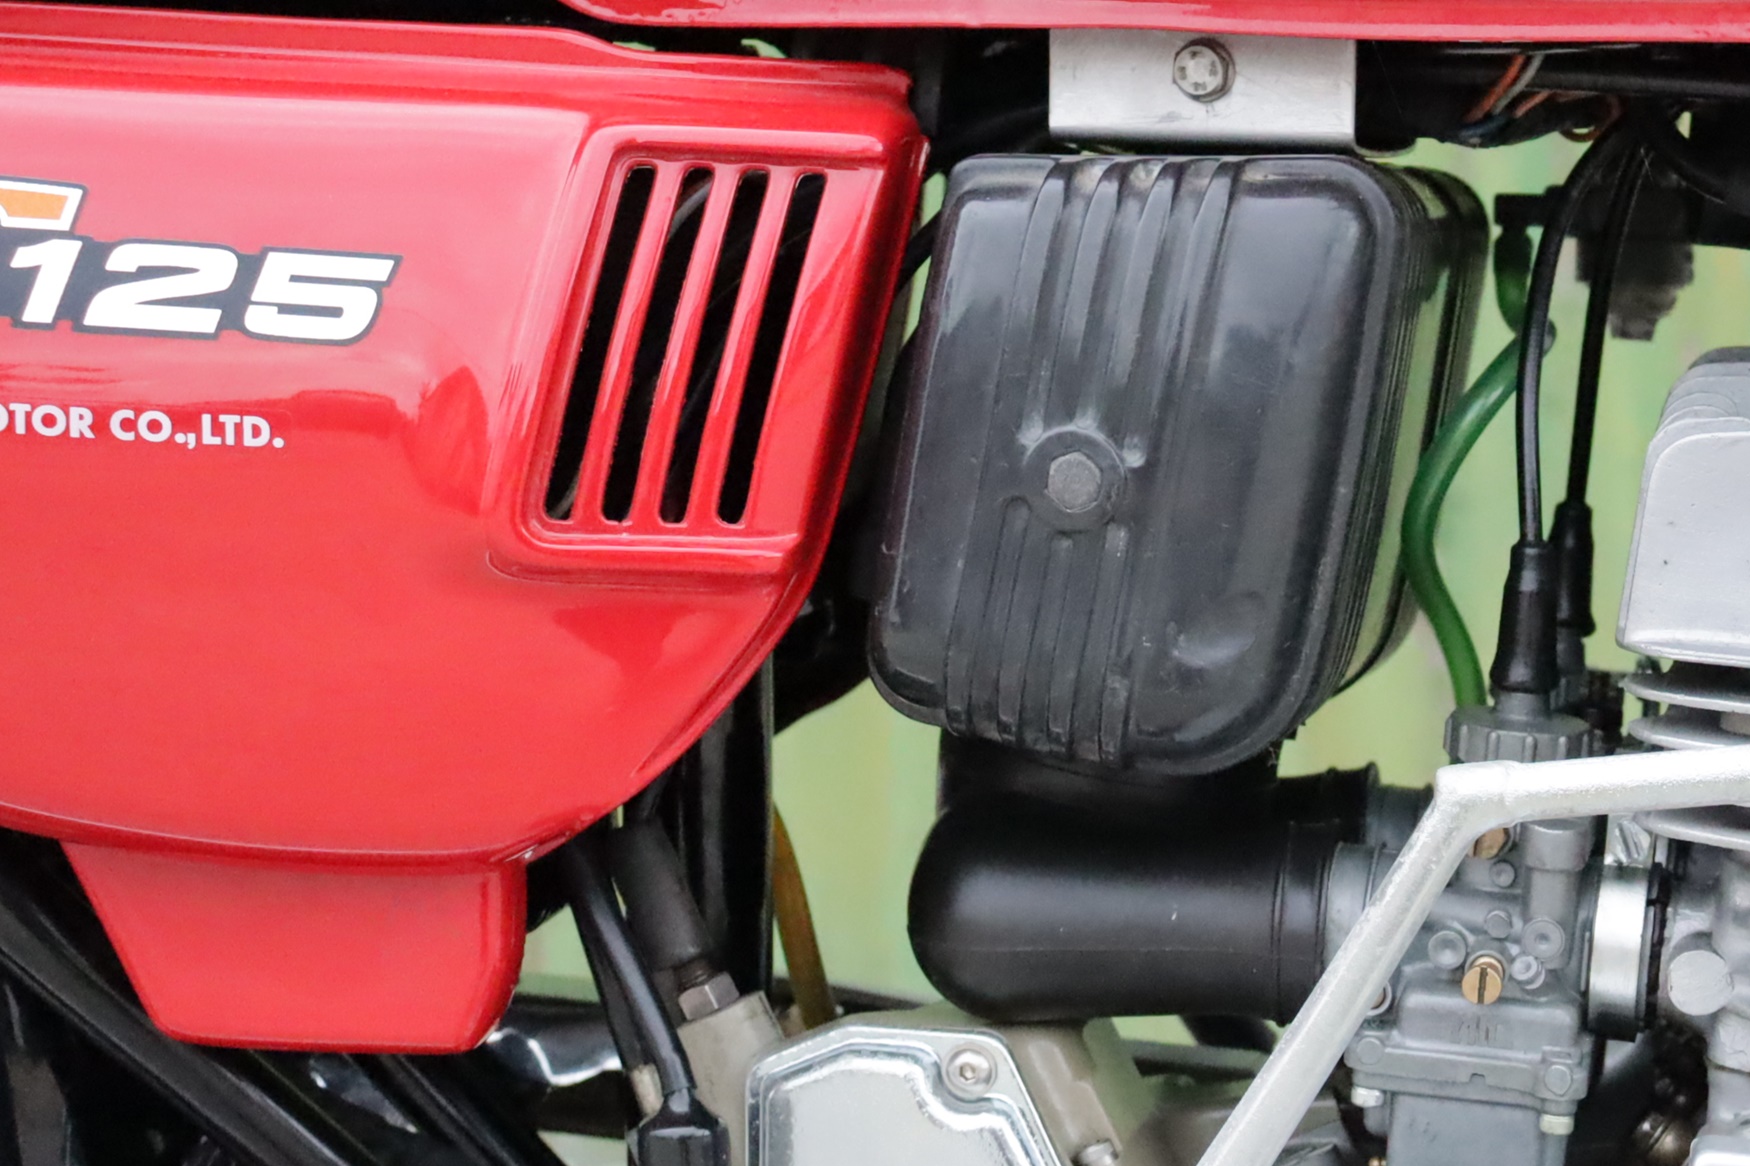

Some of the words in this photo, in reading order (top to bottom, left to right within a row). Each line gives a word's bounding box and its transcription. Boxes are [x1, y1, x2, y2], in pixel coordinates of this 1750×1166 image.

[9, 238, 396, 341] 125
[0, 402, 95, 439] TOR
[109, 408, 285, 450] CO.,LTD.
